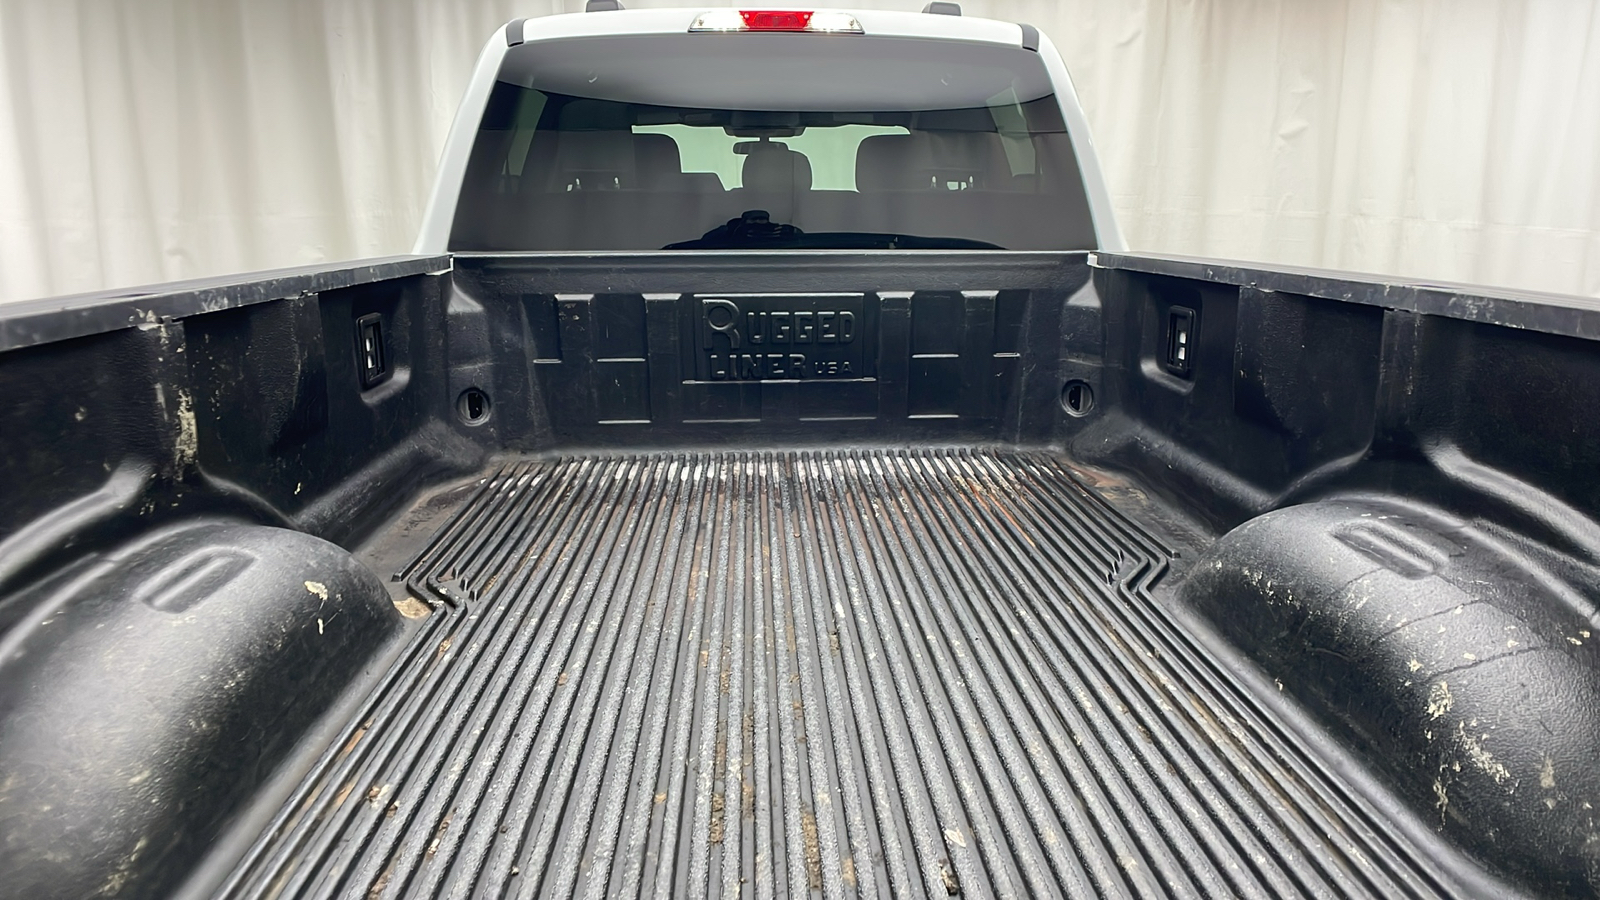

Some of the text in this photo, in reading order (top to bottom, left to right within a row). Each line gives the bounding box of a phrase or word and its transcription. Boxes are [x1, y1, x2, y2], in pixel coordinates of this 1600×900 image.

[702, 299, 855, 350] RUGGED
[710, 354, 853, 379] LINER USA
